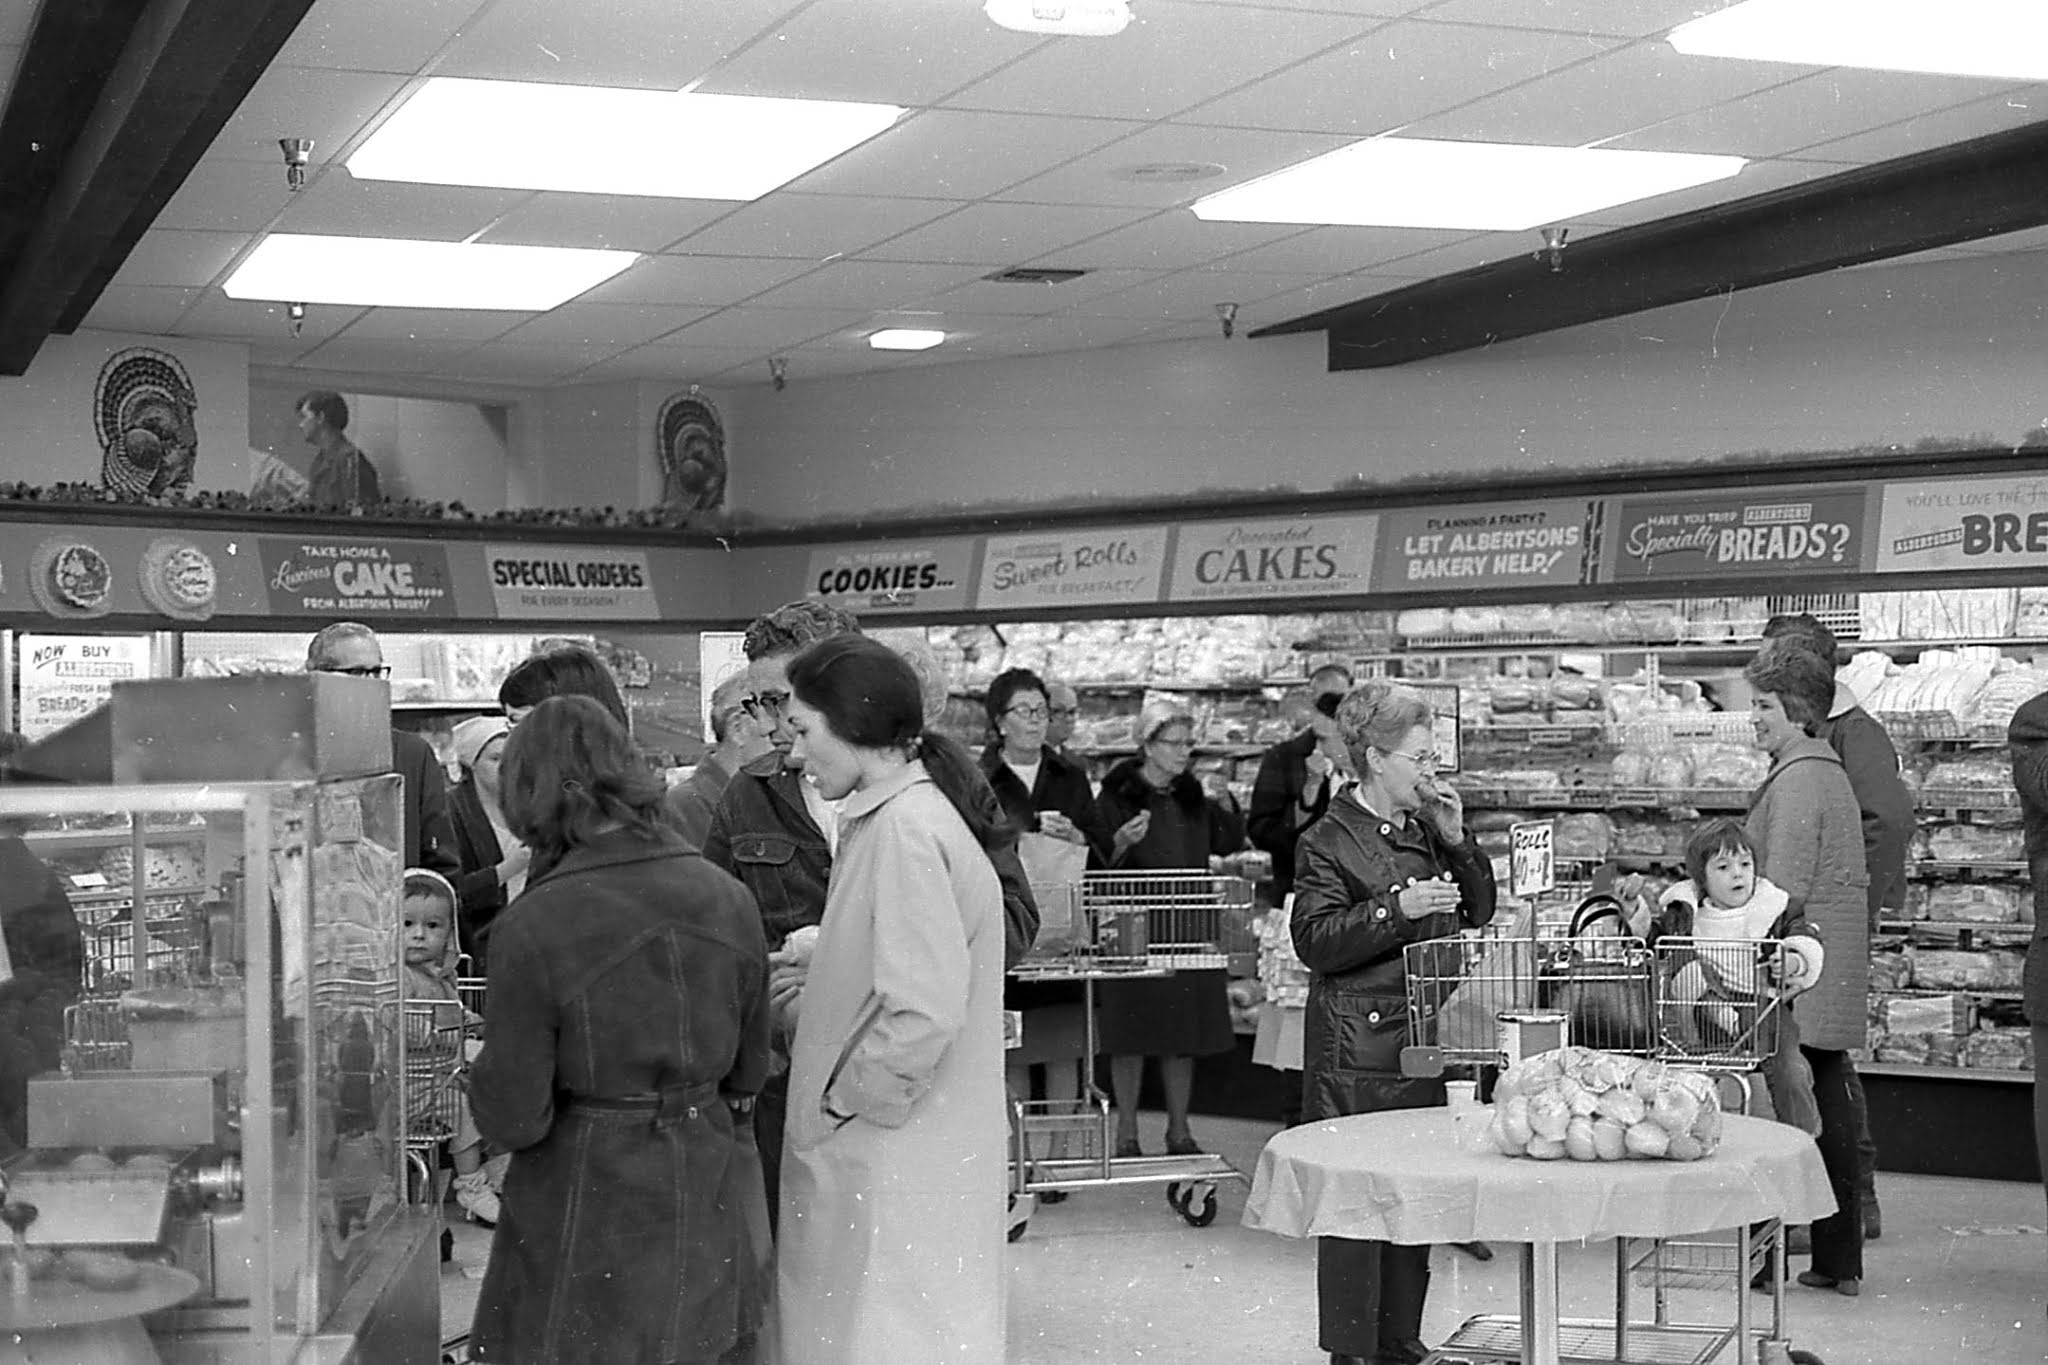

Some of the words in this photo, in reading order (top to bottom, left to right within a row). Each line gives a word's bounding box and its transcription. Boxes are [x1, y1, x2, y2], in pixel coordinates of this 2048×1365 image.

[1959, 491, 1991, 506] LOVE
[1648, 514, 1679, 526] HAVE
[1684, 514, 1705, 524] YOU
[302, 545, 338, 558] TAKE
[340, 547, 378, 559] HOME
[381, 549, 391, 560] A
[1404, 535, 1444, 556] LET
[1450, 526, 1579, 553] ALBERTSONS
[1626, 522, 1719, 562] Specialty
[1717, 523, 1850, 563] BREADS?
[493, 559, 576, 588] SPECIAL
[576, 562, 644, 588] ORDERS
[993, 551, 1067, 591] Sweet
[1075, 541, 1138, 571] Rolls
[1407, 555, 1489, 580] BAKERY
[1492, 550, 1564, 575] HELP!
[33, 645, 67, 663] NOW
[82, 645, 111, 657] BUY
[39, 697, 87, 713] BREADS
